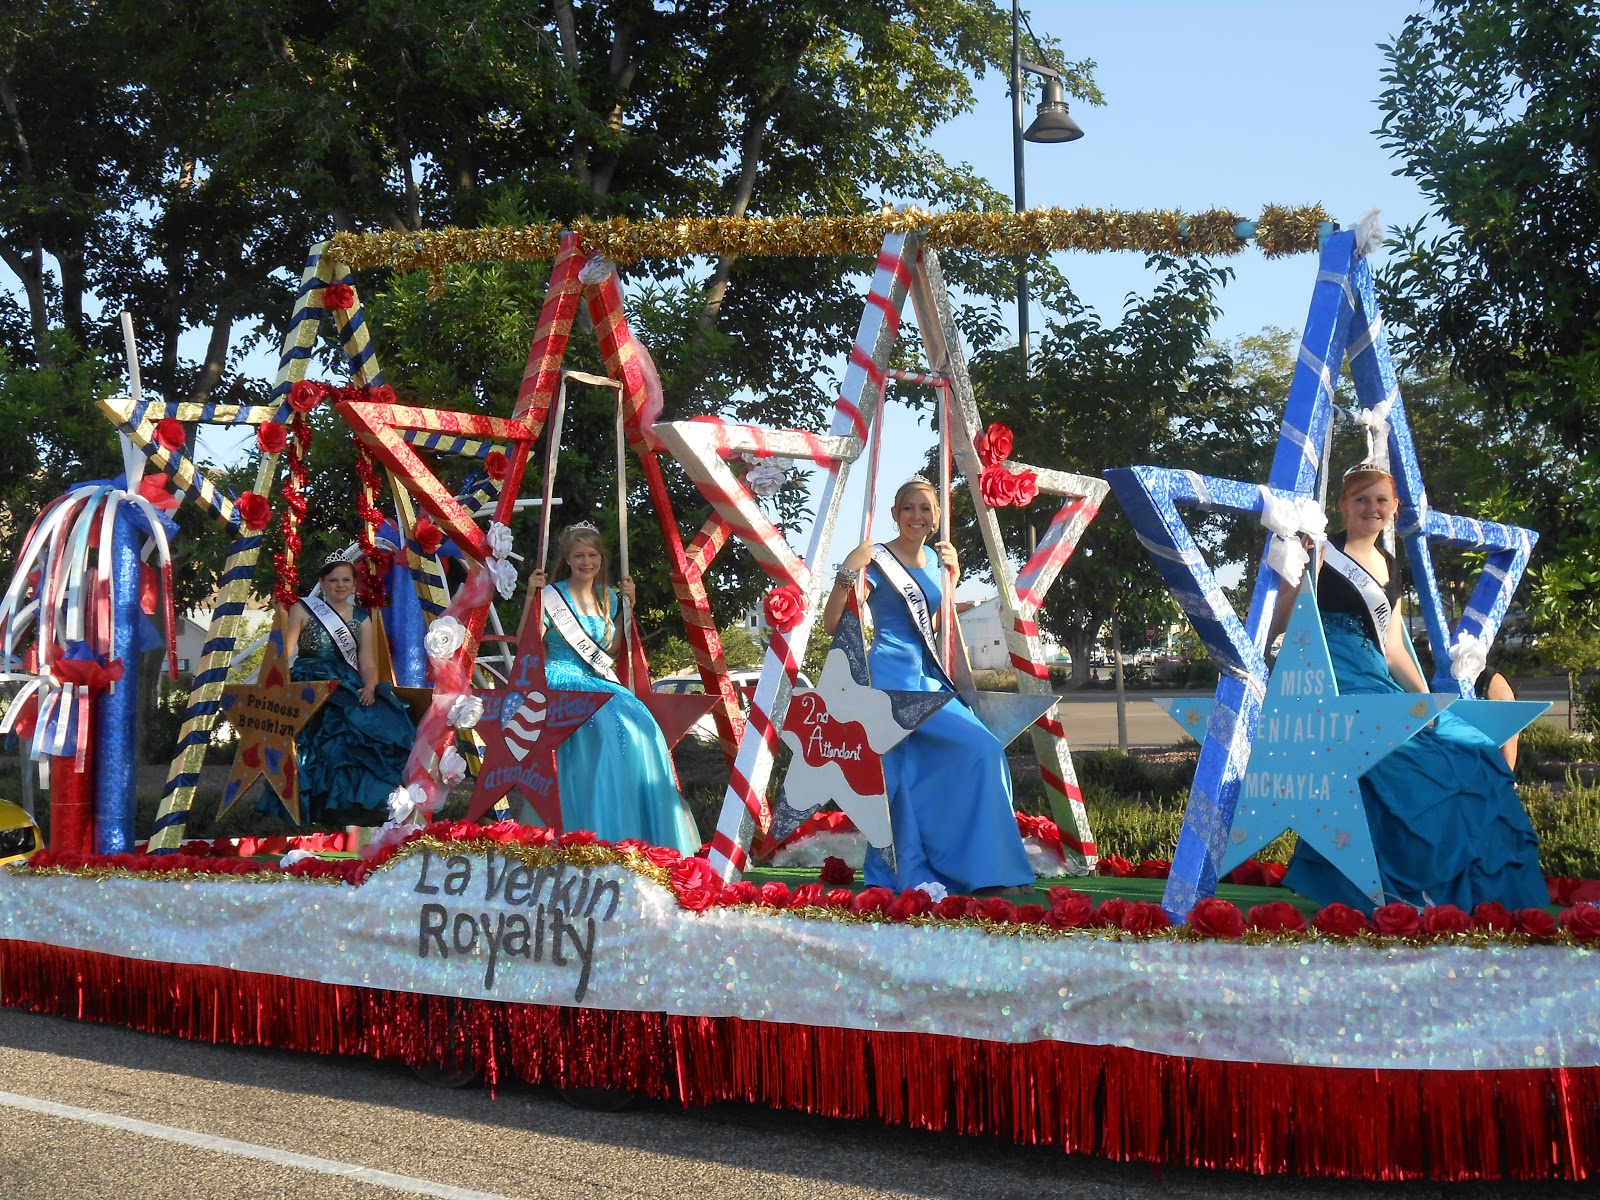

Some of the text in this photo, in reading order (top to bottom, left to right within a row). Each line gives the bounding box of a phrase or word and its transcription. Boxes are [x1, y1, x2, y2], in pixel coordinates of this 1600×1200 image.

[1374, 603, 1388, 632] Miss
[335, 626, 349, 648] Miss
[514, 655, 540, 687] 1st
[1281, 669, 1325, 696] MISS
[247, 694, 300, 718] Princess
[801, 696, 829, 725] 2nd
[238, 714, 295, 737] Brooklyn
[807, 725, 862, 761] Attendant
[484, 762, 553, 797] attendant
[1244, 771, 1330, 801] MCKAYLA
[414, 845, 620, 922] La Verkin
[418, 903, 596, 1003] Royalty
